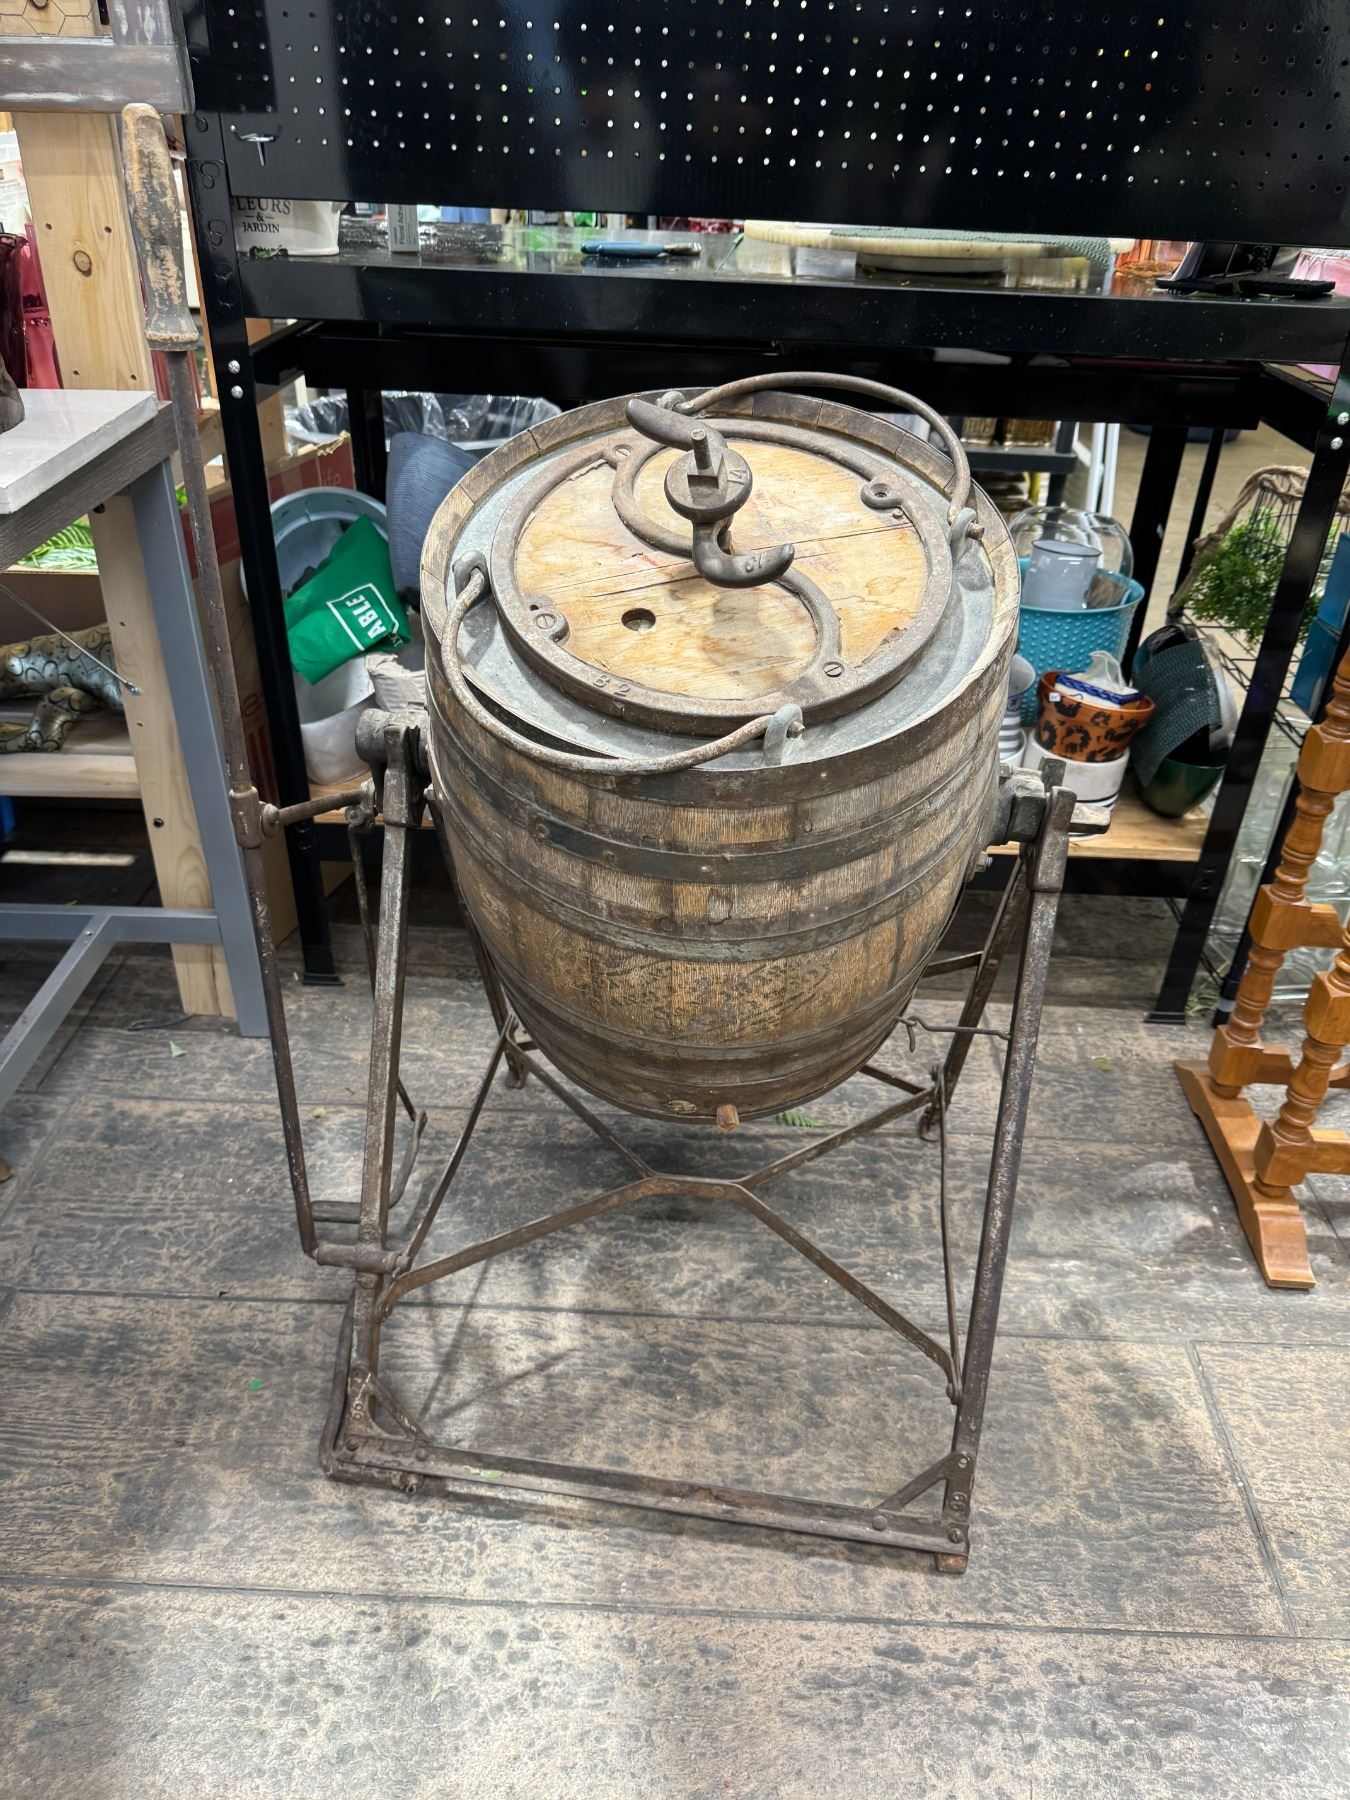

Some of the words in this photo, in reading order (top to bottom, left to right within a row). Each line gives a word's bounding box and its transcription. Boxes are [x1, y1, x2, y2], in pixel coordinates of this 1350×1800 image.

[256, 212, 264, 222] &
[242, 221, 280, 233] JARDIN
[345, 594, 387, 639] ABLE
